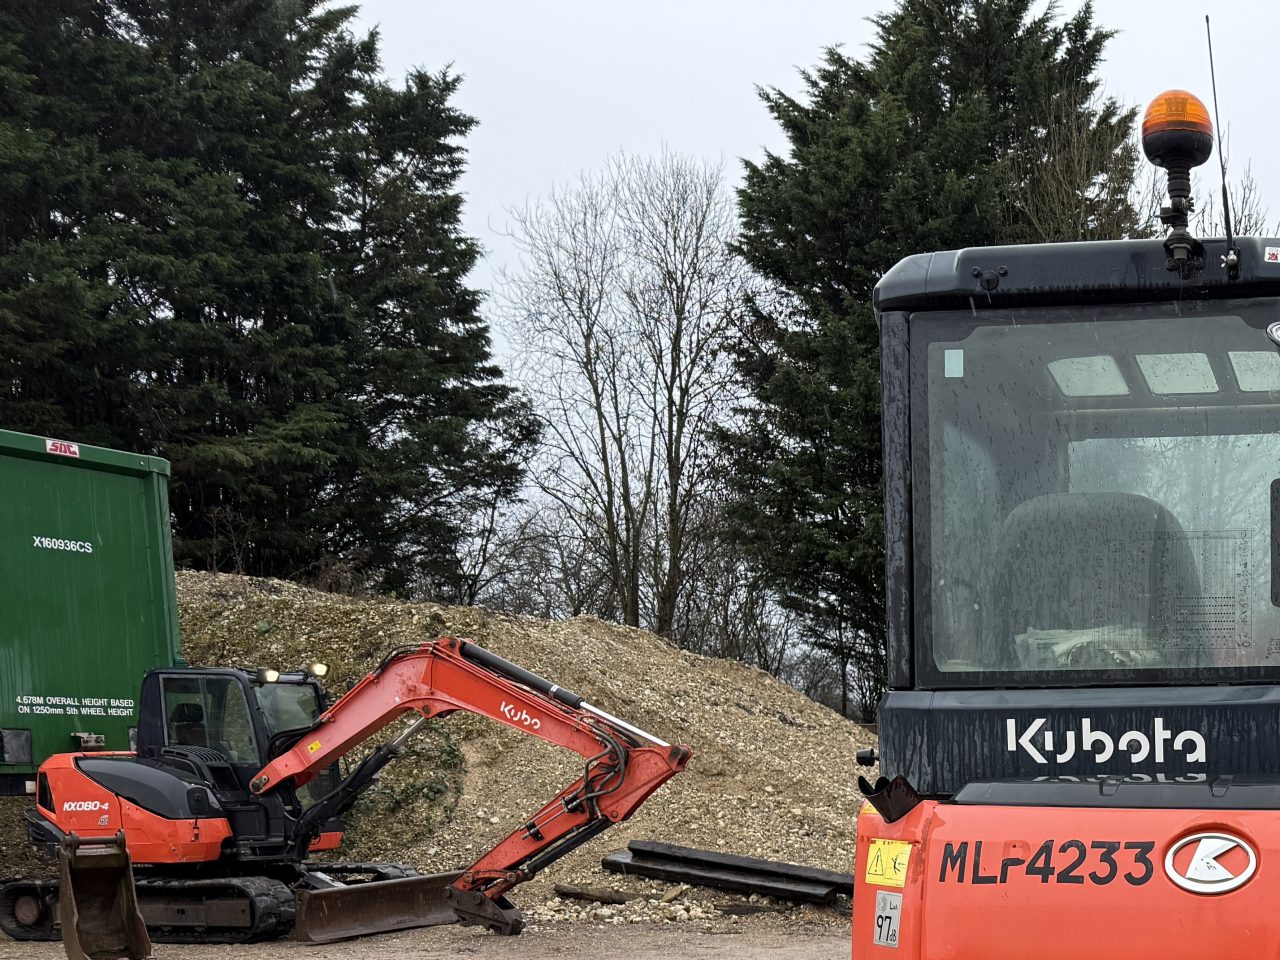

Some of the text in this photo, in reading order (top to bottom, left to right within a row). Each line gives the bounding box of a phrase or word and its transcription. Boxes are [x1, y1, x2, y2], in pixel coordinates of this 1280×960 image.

[32, 535, 93, 553] X160936CS
[15, 695, 134, 707] 4.678M OVERALL HEIGHT BASED
[18, 705, 134, 716] ON 1250mm 5th WHEEL HEIGHT
[1006, 717, 1206, 764] Kubota
[63, 800, 110, 811] KX080-4
[876, 914, 892, 942] 97
